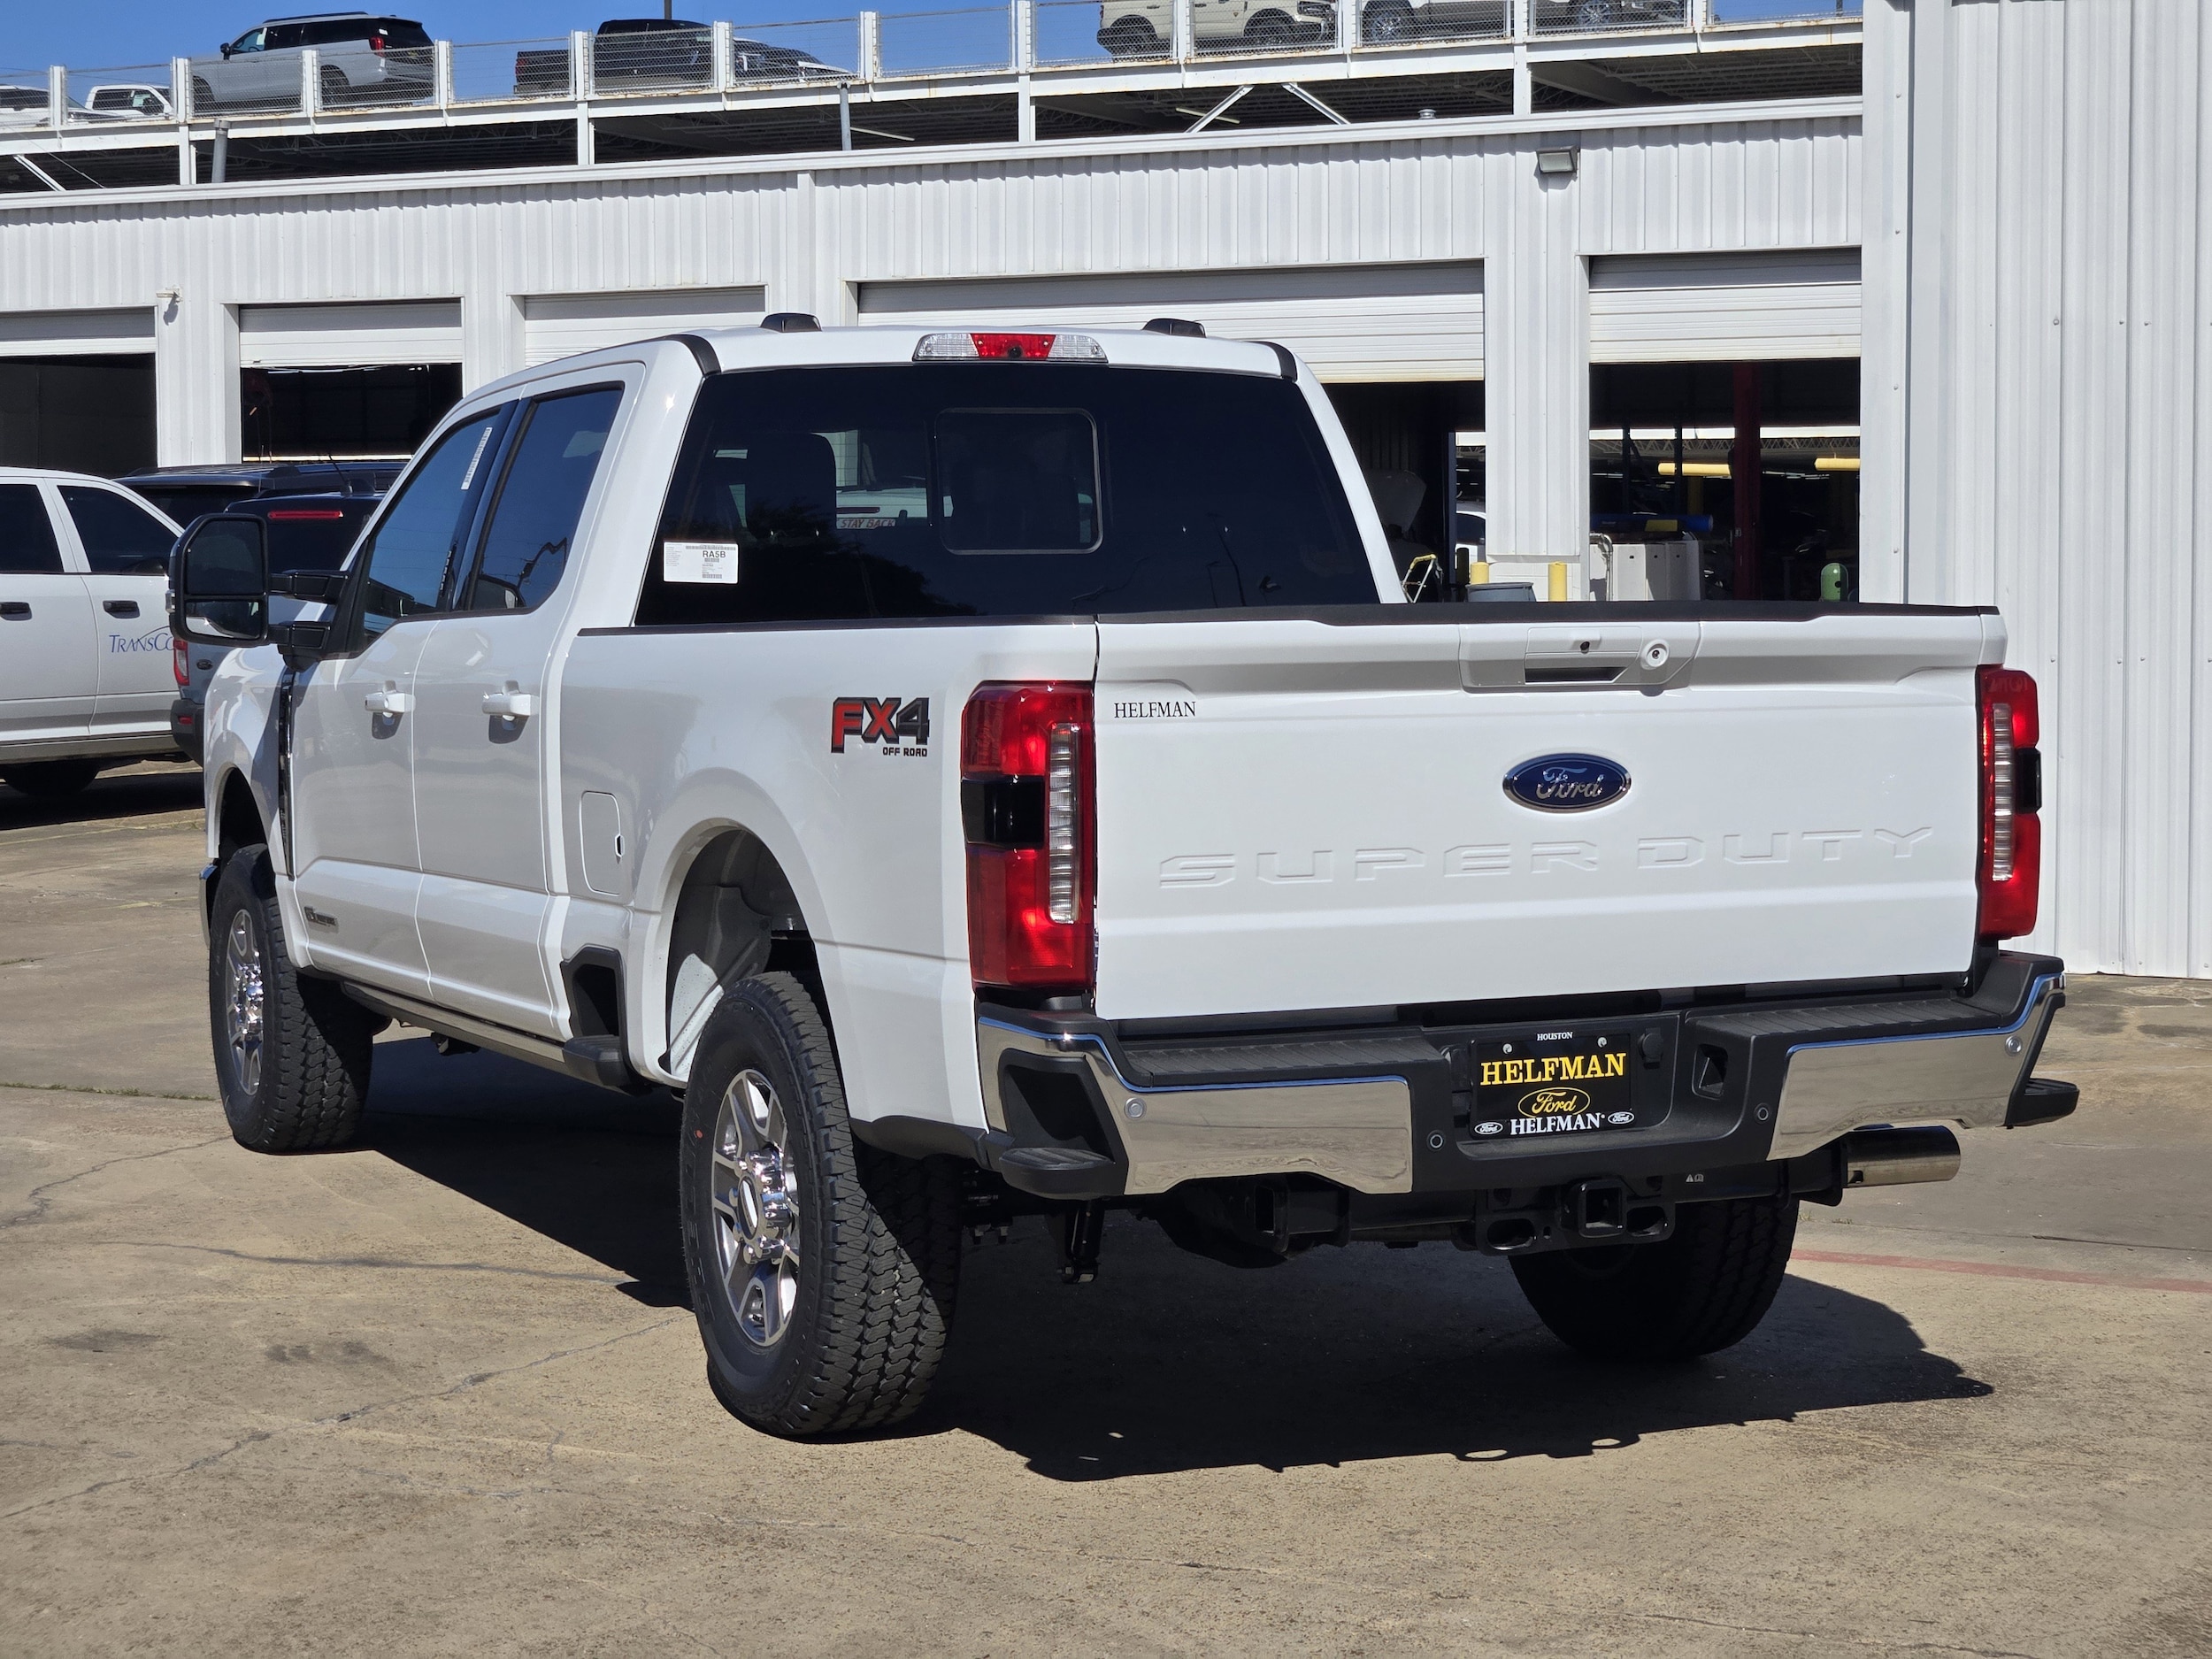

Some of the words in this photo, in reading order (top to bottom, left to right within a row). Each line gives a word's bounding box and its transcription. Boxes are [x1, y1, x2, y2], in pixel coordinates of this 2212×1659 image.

[841, 518, 864, 528] STAY
[866, 518, 895, 528] BACK
[1114, 702, 1196, 718] HELFMAN
[831, 697, 930, 753] FX4
[882, 747, 901, 757] OFF
[903, 748, 928, 757] ROAD
[1536, 766, 1605, 799] Ford
[1160, 840, 1599, 888] SUPER
[1638, 826, 1933, 870] DUTY
[1536, 1031, 1574, 1041] HOUSTON
[1479, 1052, 1627, 1087] HELFMAN
[1531, 1091, 1578, 1115] Ford
[1509, 1112, 1602, 1136] HELFMAN
